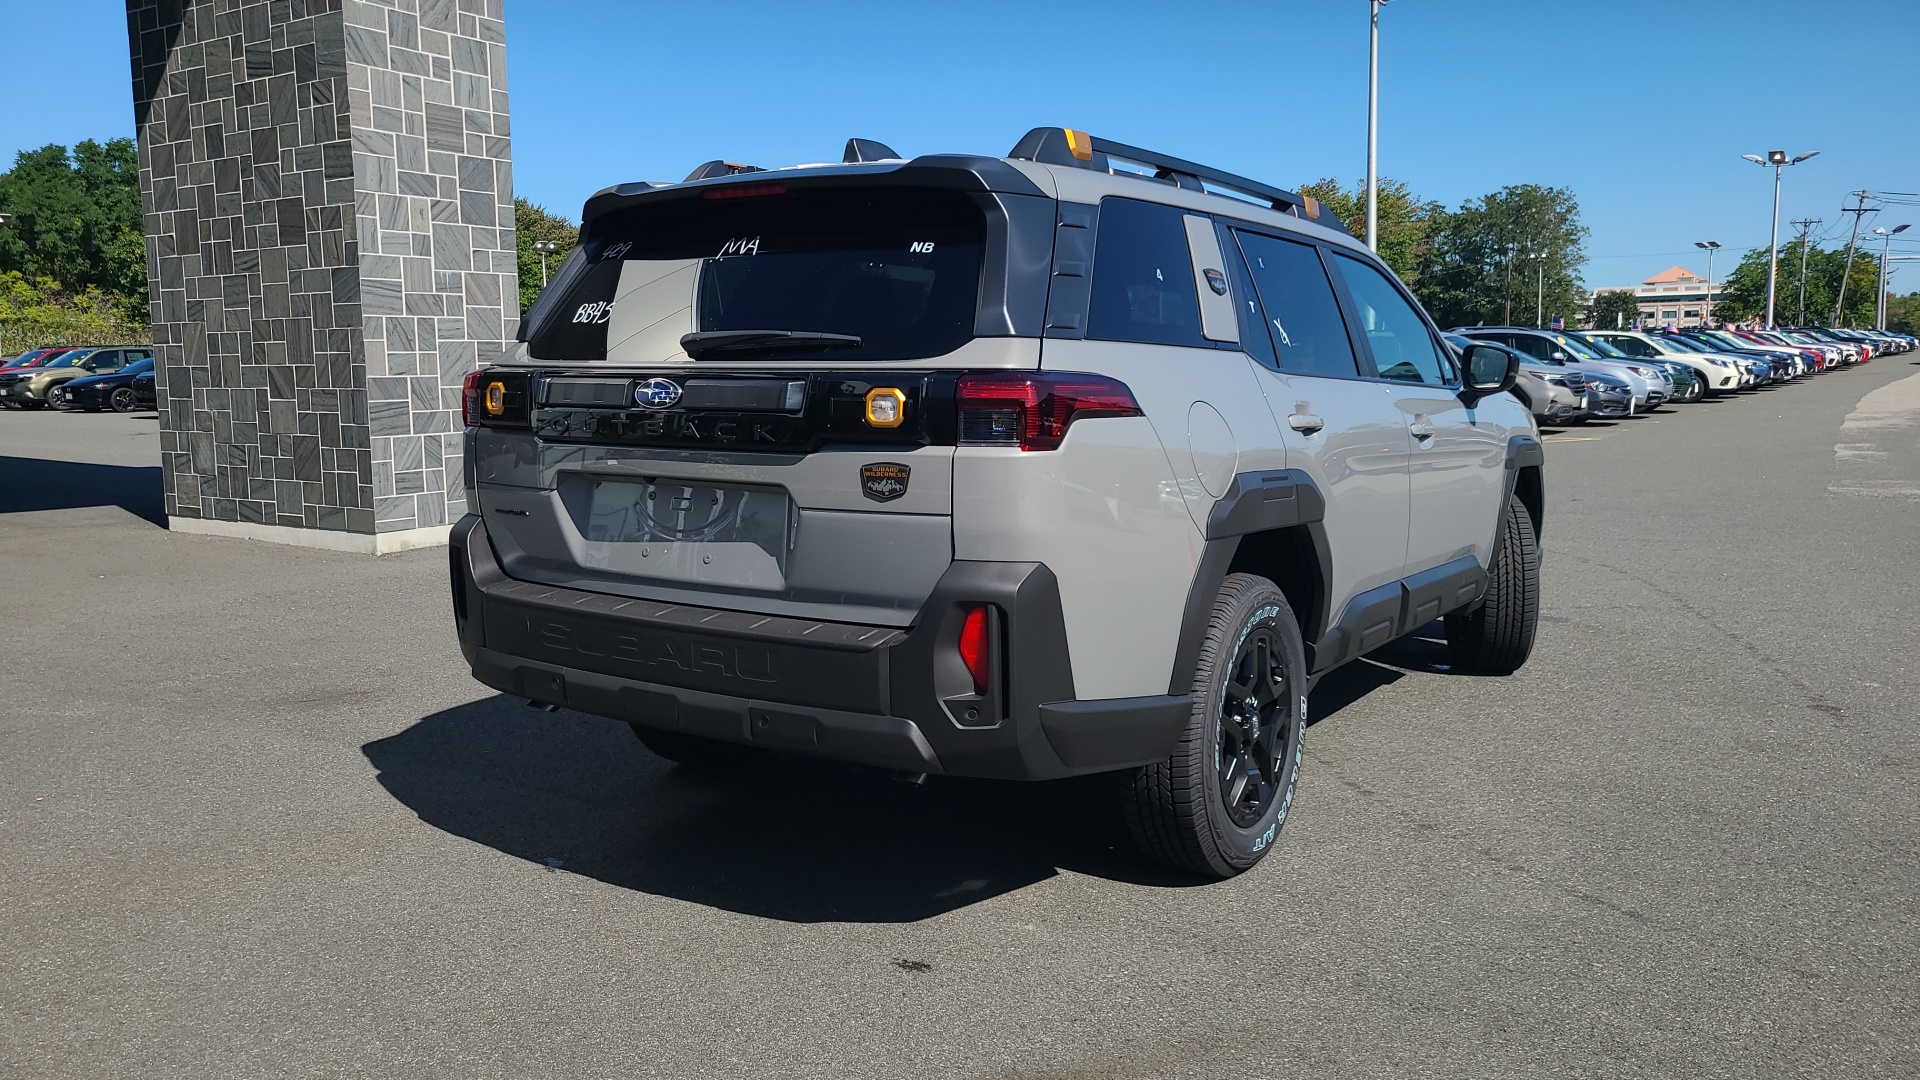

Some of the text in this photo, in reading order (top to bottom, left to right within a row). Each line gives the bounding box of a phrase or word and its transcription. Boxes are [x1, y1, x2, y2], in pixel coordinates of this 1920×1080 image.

[909, 241, 935, 253] NB
[549, 416, 777, 442] OUTBACK
[540, 622, 779, 683] SUBARU
